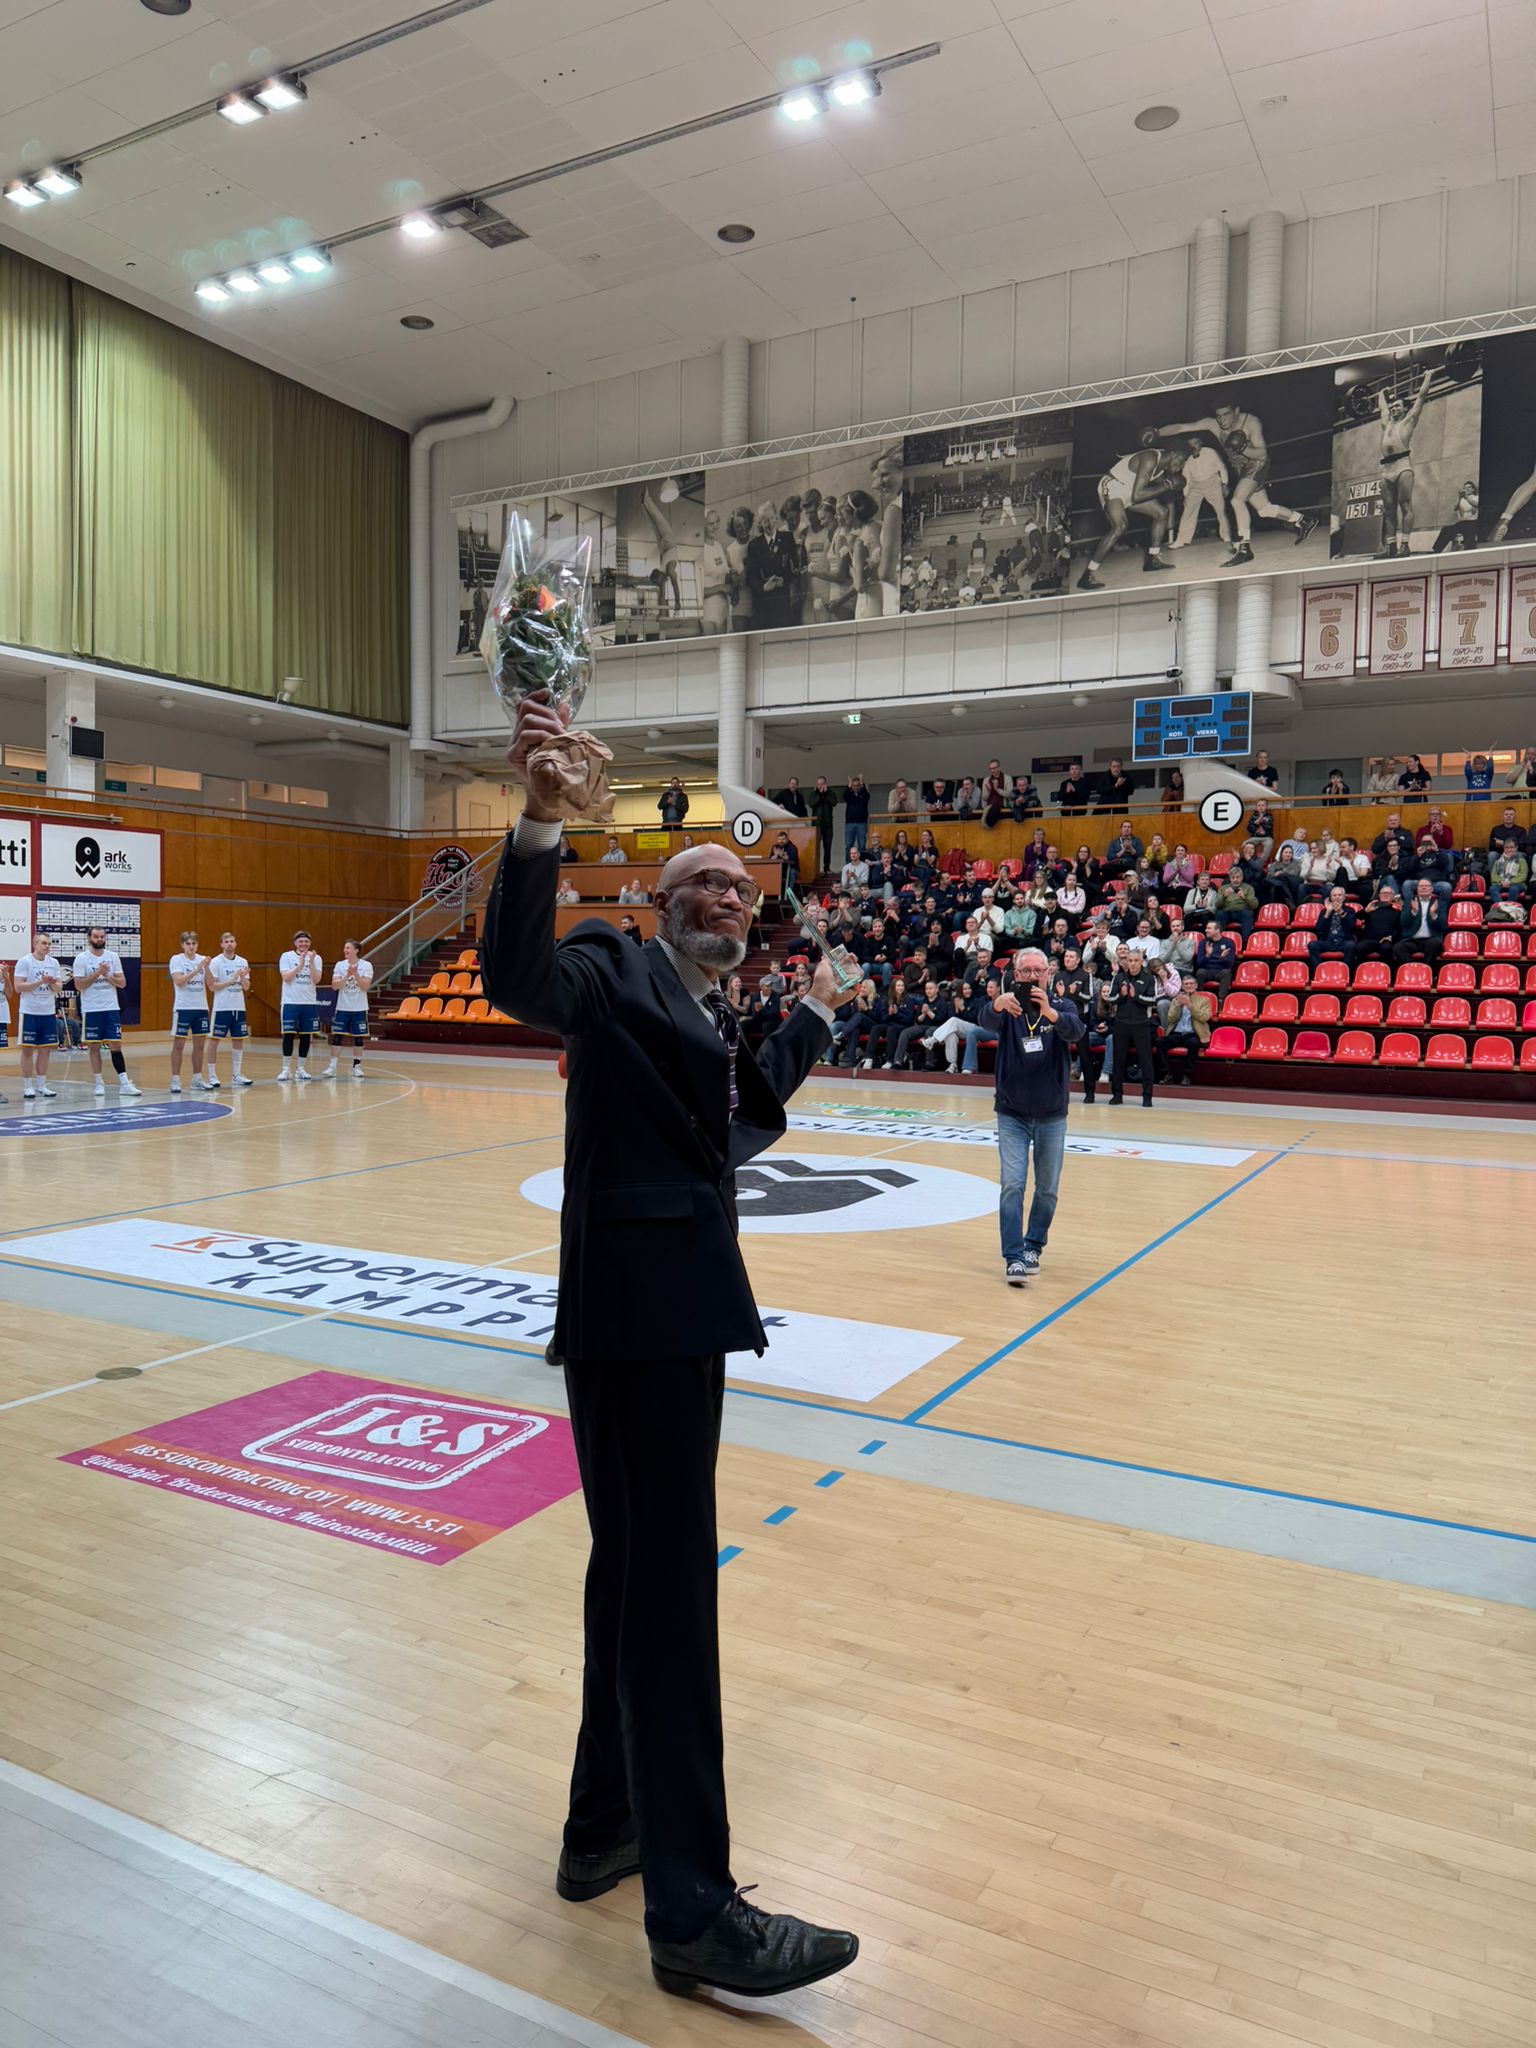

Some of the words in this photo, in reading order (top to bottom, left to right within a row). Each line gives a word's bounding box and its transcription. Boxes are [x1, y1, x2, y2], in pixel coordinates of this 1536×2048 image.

[1320, 624, 1339, 657] 6
[1387, 618, 1408, 651] 5
[1458, 611, 1479, 645] 7
[1213, 801, 1230, 822] E
[741, 820, 754, 837] D
[104, 850, 127, 863] ark
[104, 862, 133, 871] works
[11, 924, 26, 933] OY
[207, 1271, 556, 1338] KAMPPI
[315, 1406, 510, 1456] J&S
[284, 1438, 445, 1474] SUBCONTRACTING
[124, 1444, 168, 1457] J&S
[154, 1451, 312, 1496] SUBCONTRACTING
[303, 1489, 340, 1502] OY
[343, 1499, 465, 1537] WWW.J-S.FI
[290, 1511, 438, 1556] Mainostekstiilit
